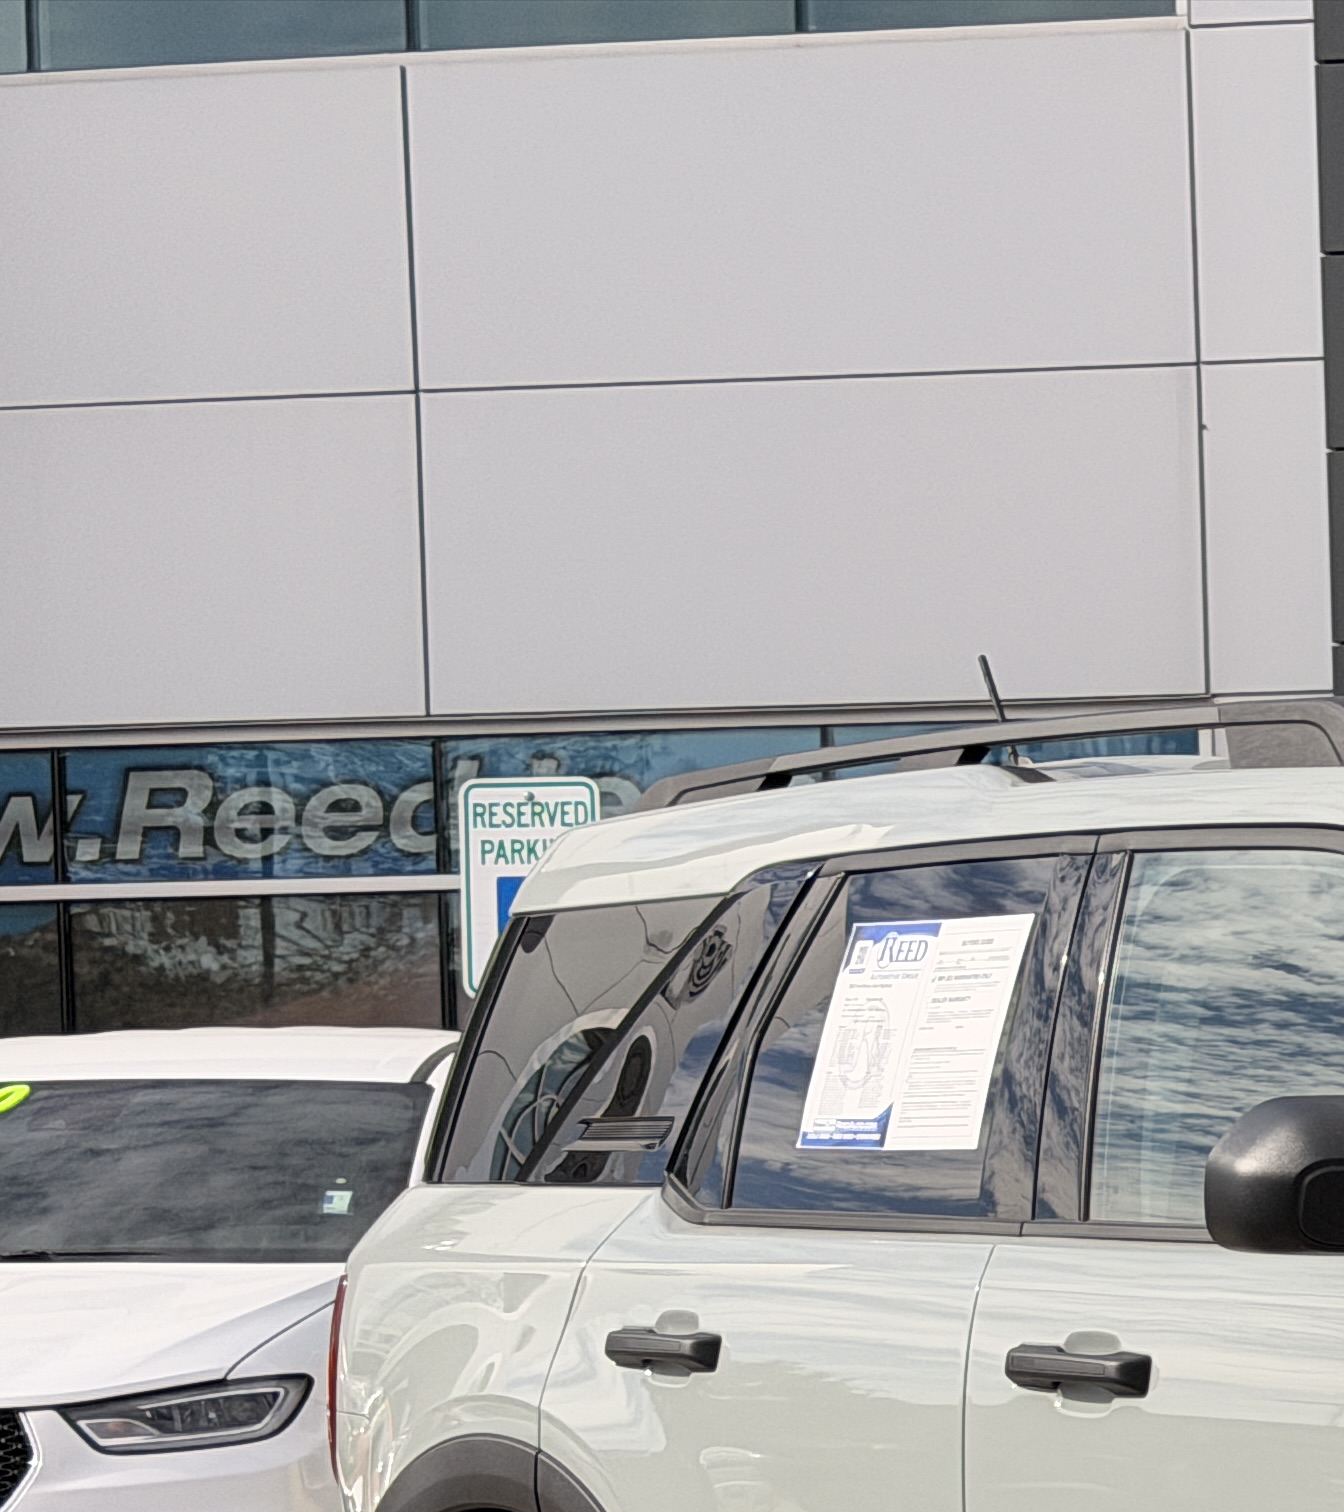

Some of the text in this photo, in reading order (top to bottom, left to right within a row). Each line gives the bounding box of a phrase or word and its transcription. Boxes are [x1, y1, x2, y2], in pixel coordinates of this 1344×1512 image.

[472, 800, 589, 829] RESERVED
[480, 838, 556, 866] PARKI
[877, 935, 929, 969] REED
